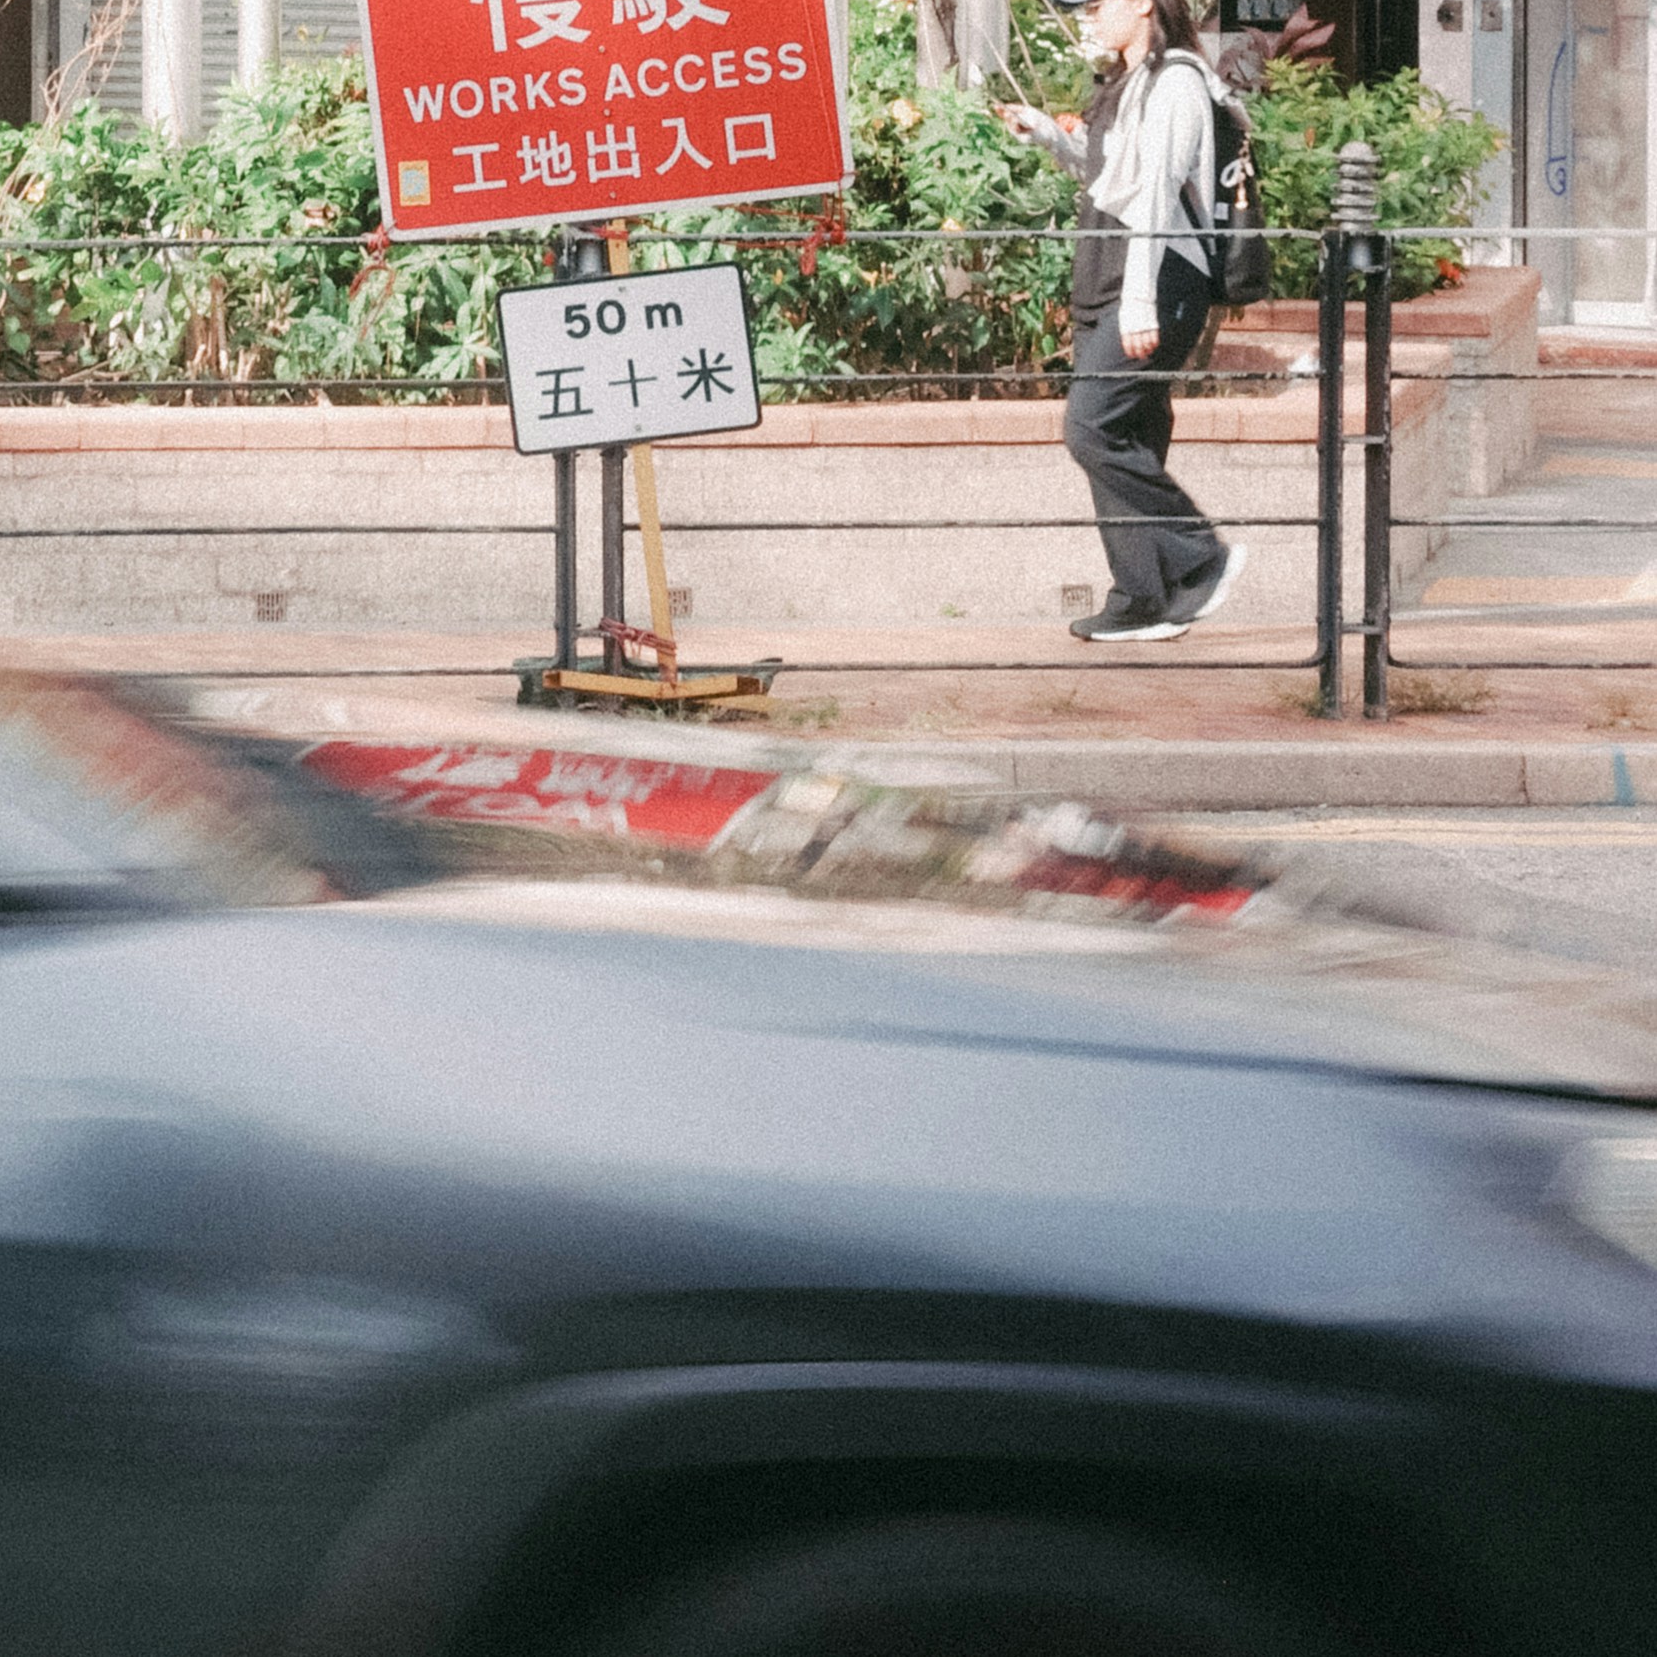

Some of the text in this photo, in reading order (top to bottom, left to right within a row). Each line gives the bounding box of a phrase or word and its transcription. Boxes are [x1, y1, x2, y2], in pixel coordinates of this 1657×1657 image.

[403, 41, 808, 123] WORKS ACCESS
[452, 112, 779, 195] 工地出入口
[563, 299, 684, 339] 50 m
[535, 347, 737, 421] 五十米
